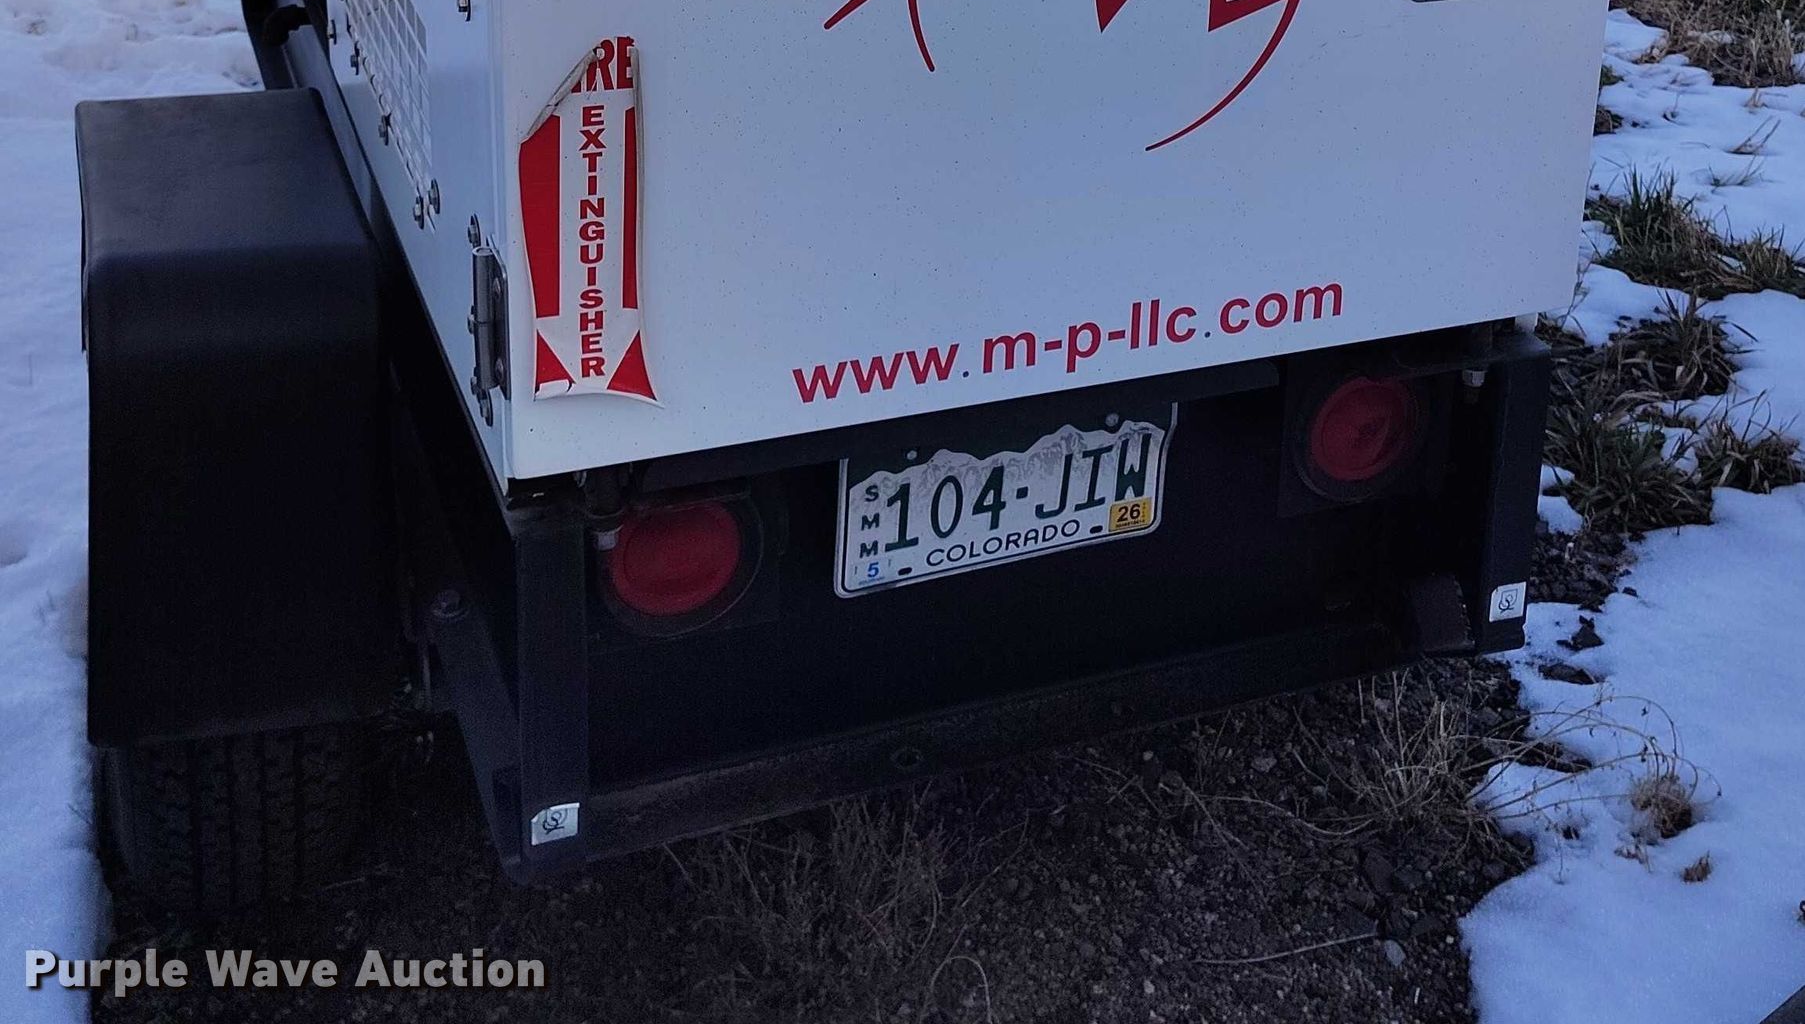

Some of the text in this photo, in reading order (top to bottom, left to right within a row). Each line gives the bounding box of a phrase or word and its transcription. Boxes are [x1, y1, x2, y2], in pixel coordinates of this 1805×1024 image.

[578, 105, 606, 378] EXTINGUISHER
[792, 282, 1344, 403] www.m-p-llc.com
[1117, 504, 1141, 523] 26
[926, 519, 1081, 567] COLORADO
[867, 562, 880, 578] 5
